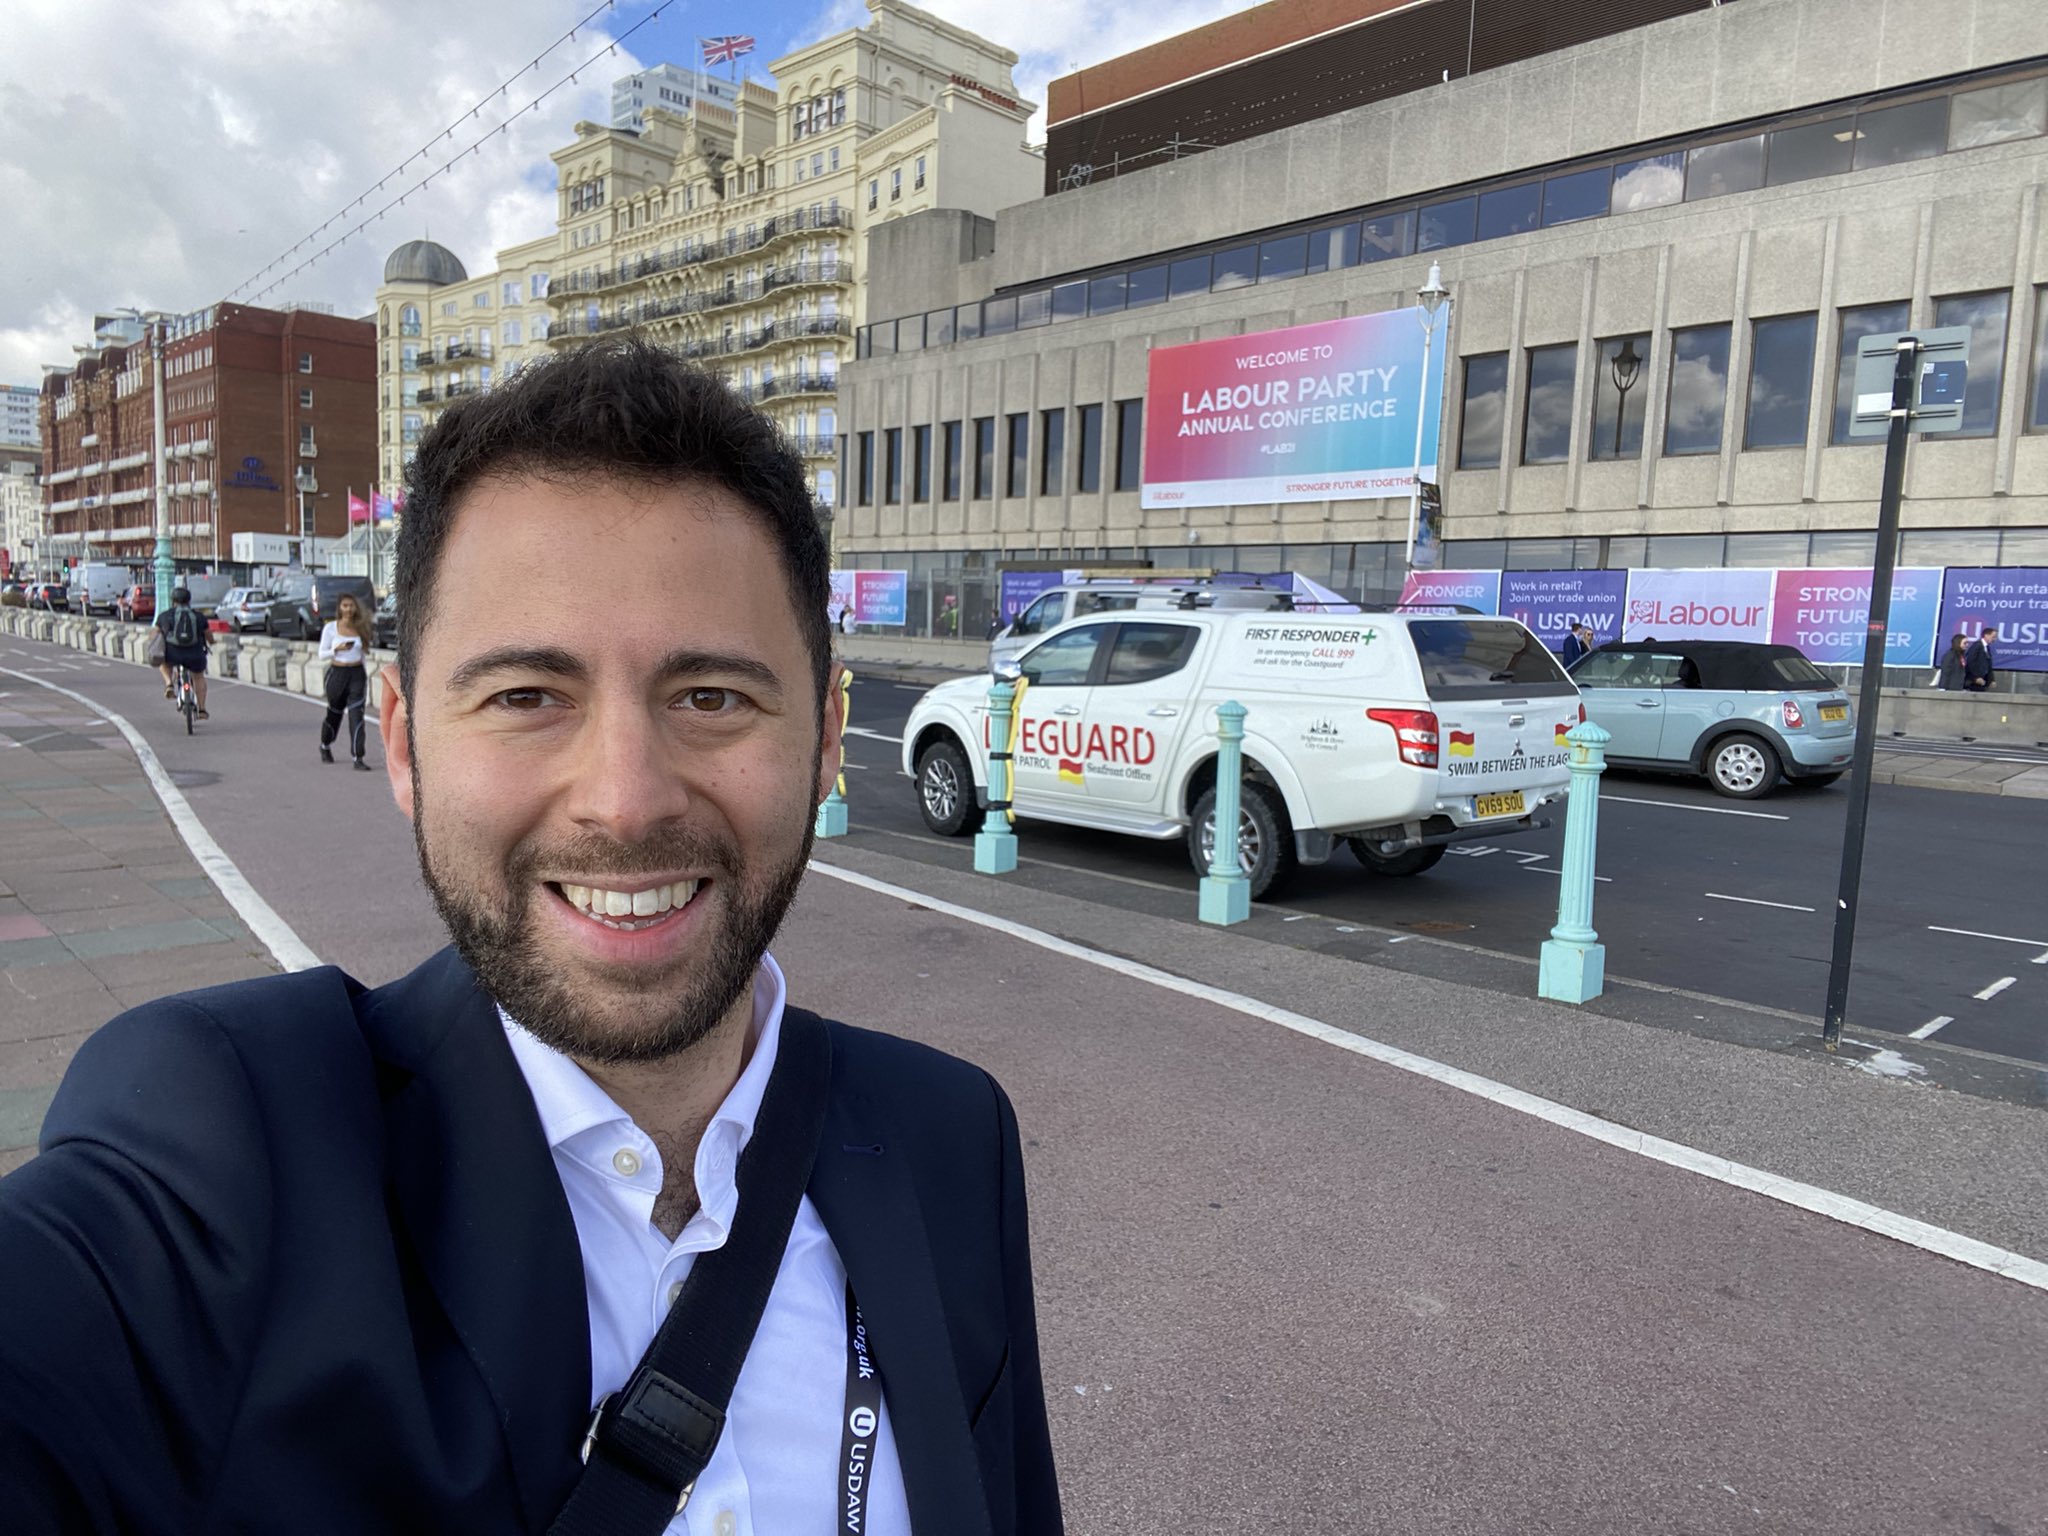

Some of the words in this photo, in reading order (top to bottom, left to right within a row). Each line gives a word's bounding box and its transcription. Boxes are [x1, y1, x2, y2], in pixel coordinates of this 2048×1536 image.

[1236, 348, 1309, 371] WELCOME
[1312, 345, 1333, 359] TO
[1182, 379, 1290, 415] LABOUR
[1299, 365, 1399, 402] PARTY
[1177, 414, 1254, 438] ANNUAL
[1258, 400, 1396, 430] CONFERENCE
[1286, 482, 1331, 493] STRONGER
[1333, 480, 1368, 490] FUTURE
[1371, 477, 1413, 488] TOGETHE
[1419, 585, 1485, 598] TRONGER
[1510, 581, 1537, 591] Work
[1539, 581, 1549, 591] in
[1551, 580, 1583, 591] retail?
[1958, 582, 1996, 594] Work
[2000, 582, 2014, 594] in
[1509, 593, 1531, 603] Join
[1533, 594, 1556, 605] your
[1558, 593, 1585, 603] trade
[1587, 593, 1617, 603] union
[1799, 586, 1918, 602] STRONER
[1955, 596, 1987, 608] Join
[1989, 599, 2025, 611] your
[1538, 612, 1615, 630] USDAW
[1654, 600, 1764, 627] Labour
[1797, 609, 1868, 624] FUTUR
[1245, 629, 1280, 640] FIRST
[1280, 629, 1360, 643] RESPONDER
[1961, 622, 1982, 641] U
[1796, 632, 1912, 647] TOGETER
[1274, 649, 1311, 658] emergency
[1312, 648, 1335, 658] CALL
[1337, 648, 1355, 658] 999
[1279, 658, 1290, 666] for
[1303, 659, 1345, 669] Coastguard
[985, 715, 1156, 766] LEGUARD
[1019, 755, 1051, 769] PATROL
[1086, 762, 1125, 777] Seafront
[1448, 761, 1479, 777] SWIM
[1481, 758, 1527, 774] BETWEEN
[1529, 755, 1546, 769] THE
[1477, 798, 1503, 815] GV69
[1504, 794, 1523, 811] SOU
[847, 1443, 867, 1534] USDAW
